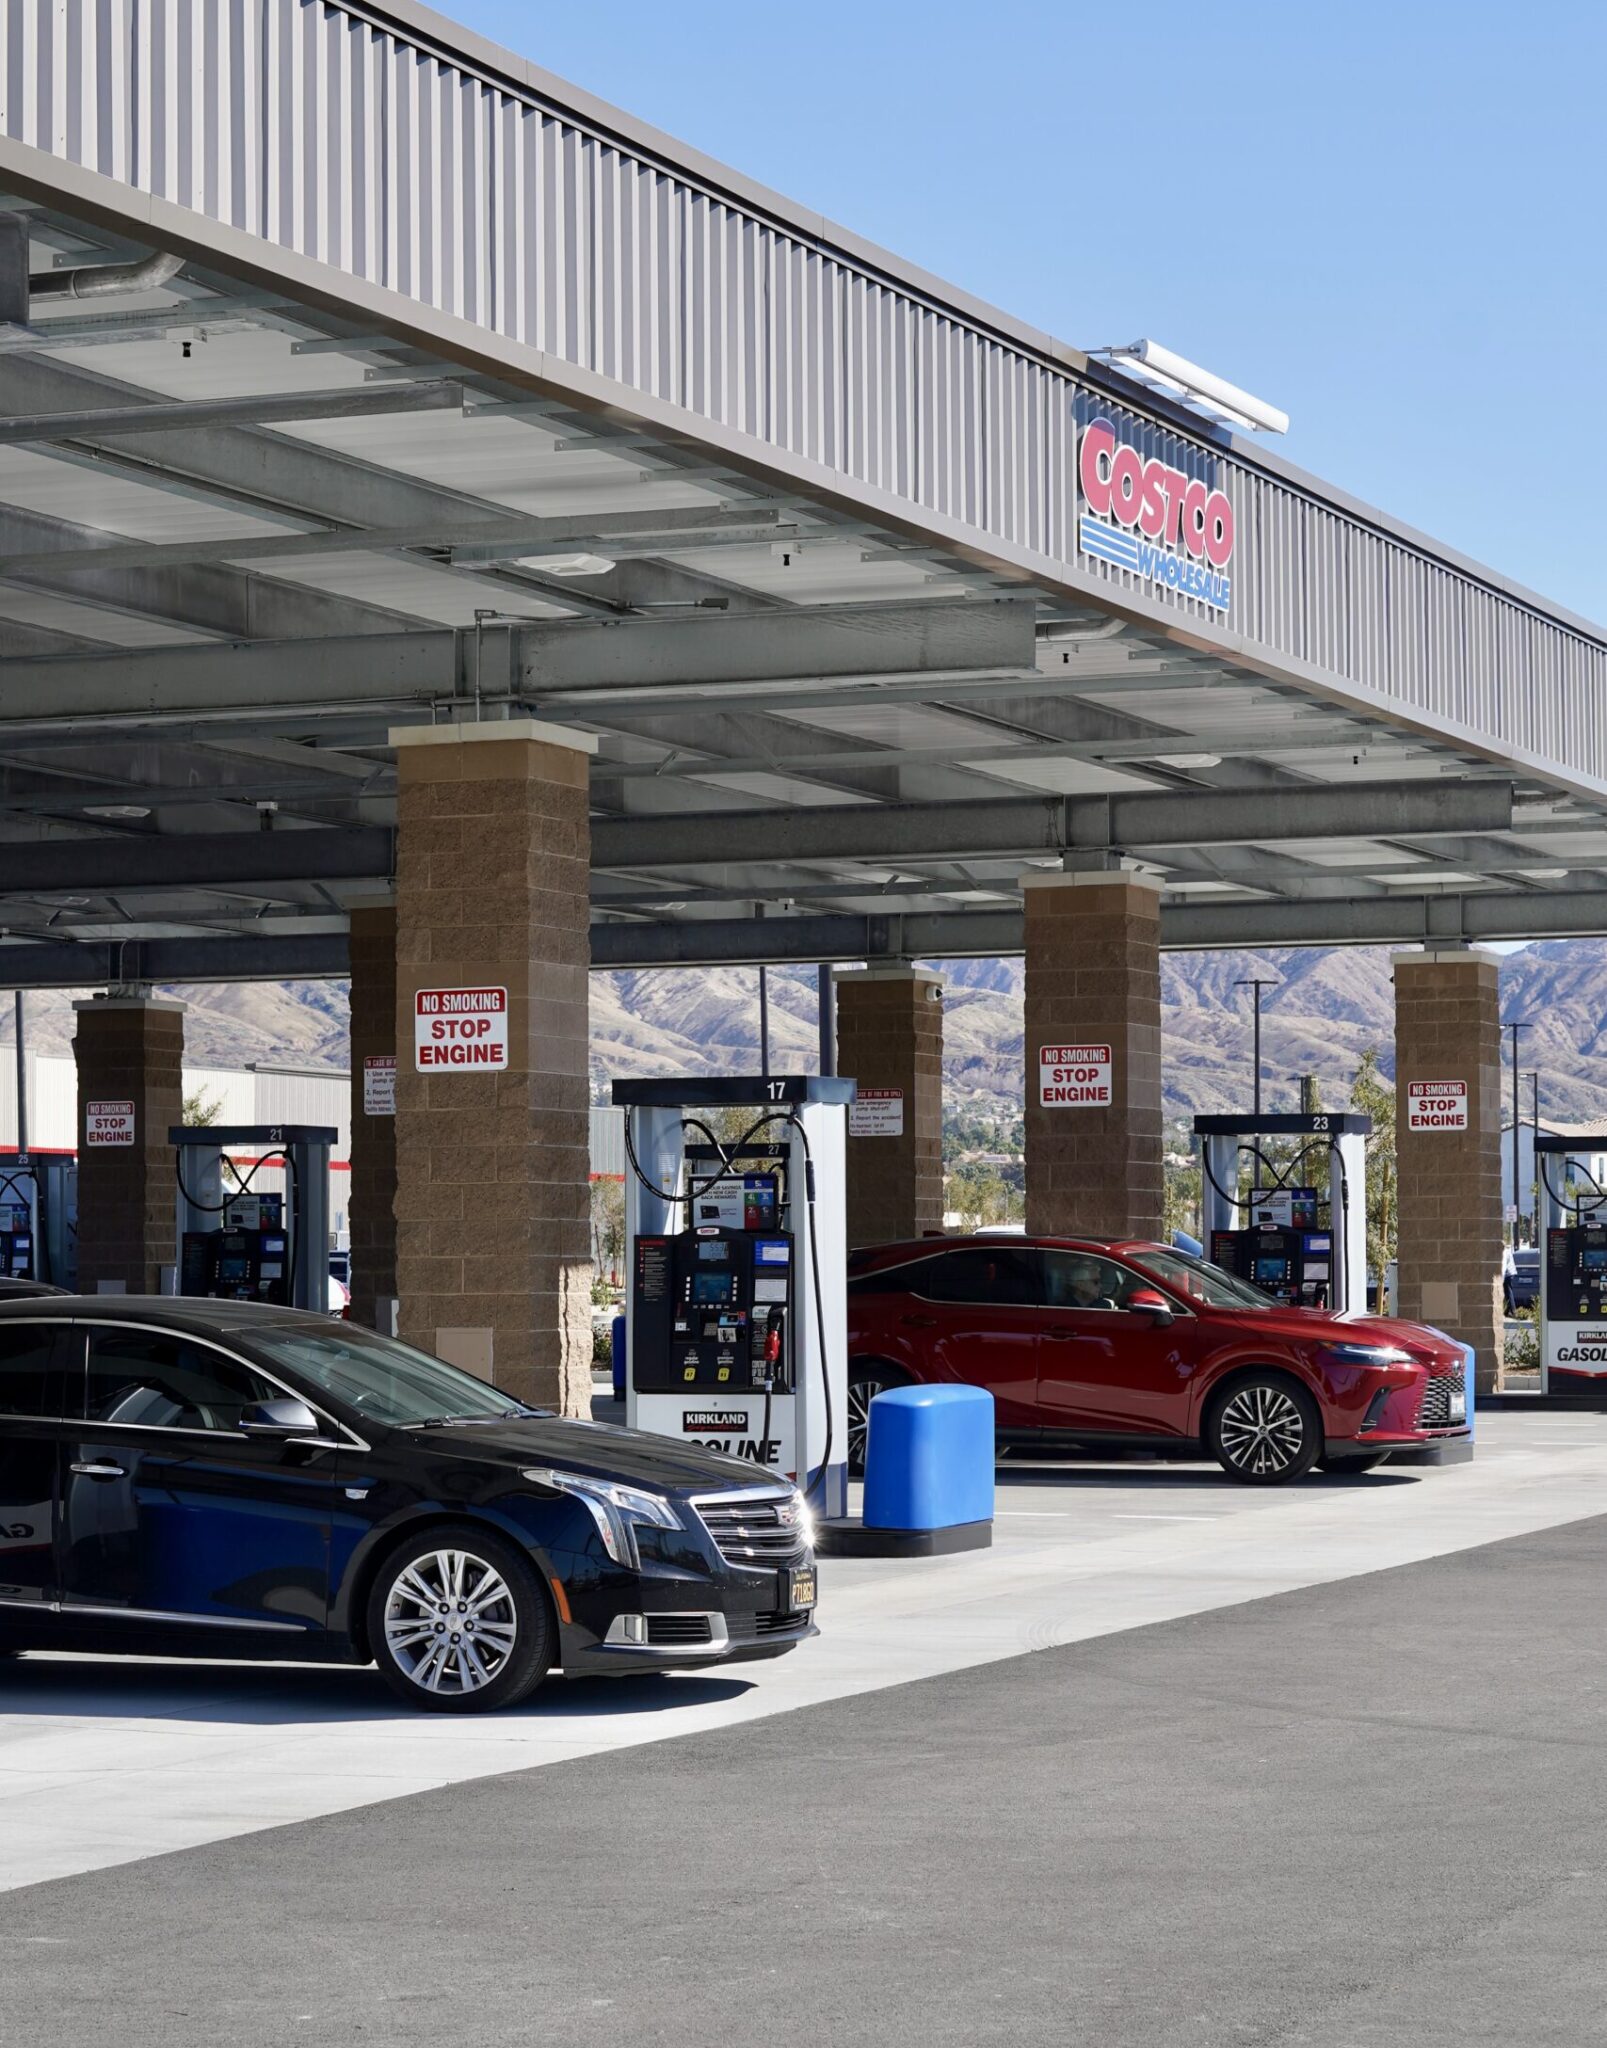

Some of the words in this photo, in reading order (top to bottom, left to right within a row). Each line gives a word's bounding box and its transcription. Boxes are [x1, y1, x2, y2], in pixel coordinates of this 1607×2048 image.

[1080, 416, 1234, 568] COSTCO
[1136, 540, 1231, 613] WHOLESALE
[422, 995, 439, 1012] NO
[442, 993, 500, 1012] SMOKING
[431, 1019, 491, 1039] STOP
[419, 1044, 503, 1064] ENGINE
[1045, 1049, 1058, 1063] NO
[1061, 1048, 1106, 1063] SMOKING
[1053, 1068, 1099, 1083] STOP
[767, 1081, 786, 1100] 17
[1043, 1087, 1108, 1101] ENGINE
[1412, 1085, 1424, 1096] NO
[1425, 1084, 1463, 1095] SMOKING
[90, 1104, 100, 1114] NO
[100, 1103, 131, 1114] SMOKING
[1419, 1100, 1457, 1111] STOP
[95, 1118, 126, 1129] STOP
[1313, 1117, 1329, 1130] 23
[1411, 1114, 1465, 1126] ENGINE
[89, 1131, 133, 1142] ENGINE
[269, 1128, 283, 1141] 21
[768, 1145, 780, 1155] 27
[18, 1154, 29, 1165] 25
[1557, 1347, 1607, 1362] GASOL
[686, 1413, 746, 1424] KIRKLAND
